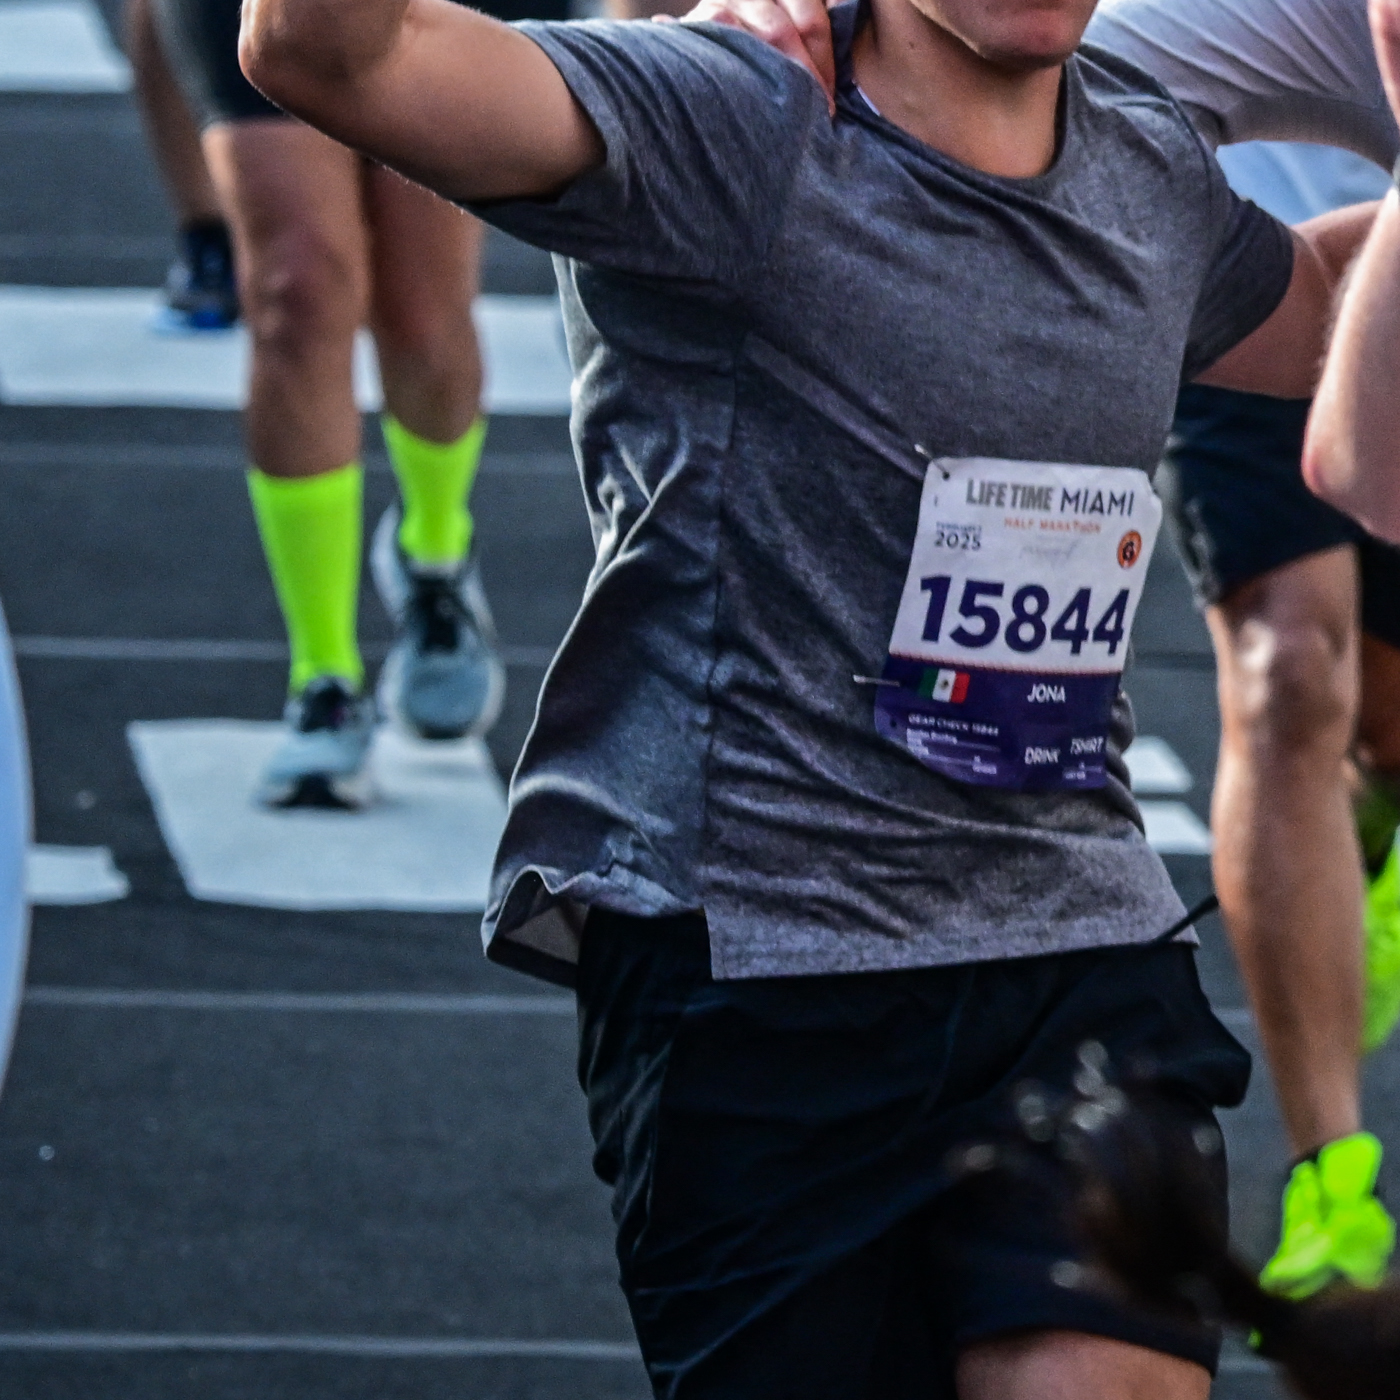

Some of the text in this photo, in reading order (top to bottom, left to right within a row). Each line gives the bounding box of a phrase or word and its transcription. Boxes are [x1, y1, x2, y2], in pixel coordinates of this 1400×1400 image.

[1060, 487, 1135, 517] MIAMI
[934, 530, 982, 551] 2025
[920, 574, 1130, 656] 15844
